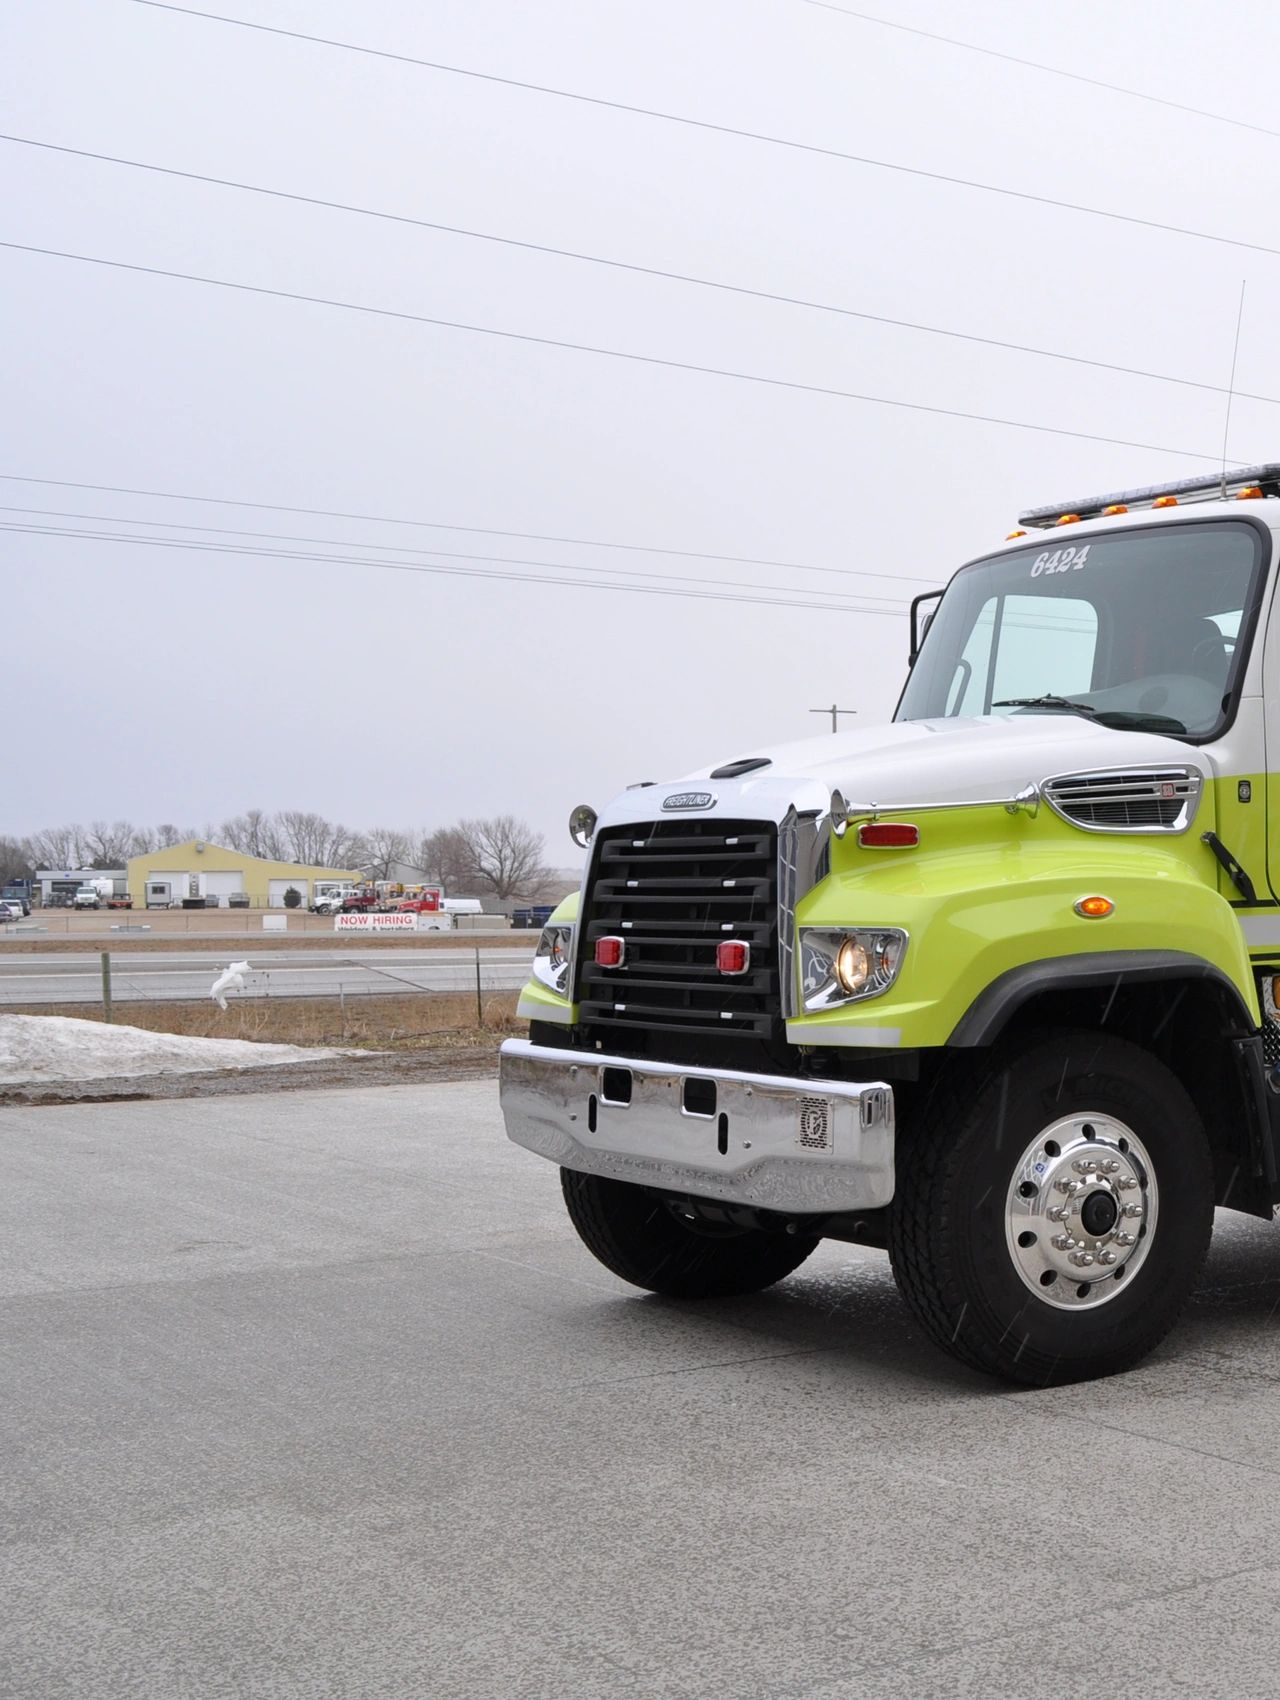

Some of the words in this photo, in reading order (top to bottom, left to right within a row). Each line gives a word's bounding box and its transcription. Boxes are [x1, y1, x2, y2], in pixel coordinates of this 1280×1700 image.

[1030, 544, 1091, 578] 6424
[340, 916, 368, 925] NOW
[373, 915, 412, 925] HIRING
